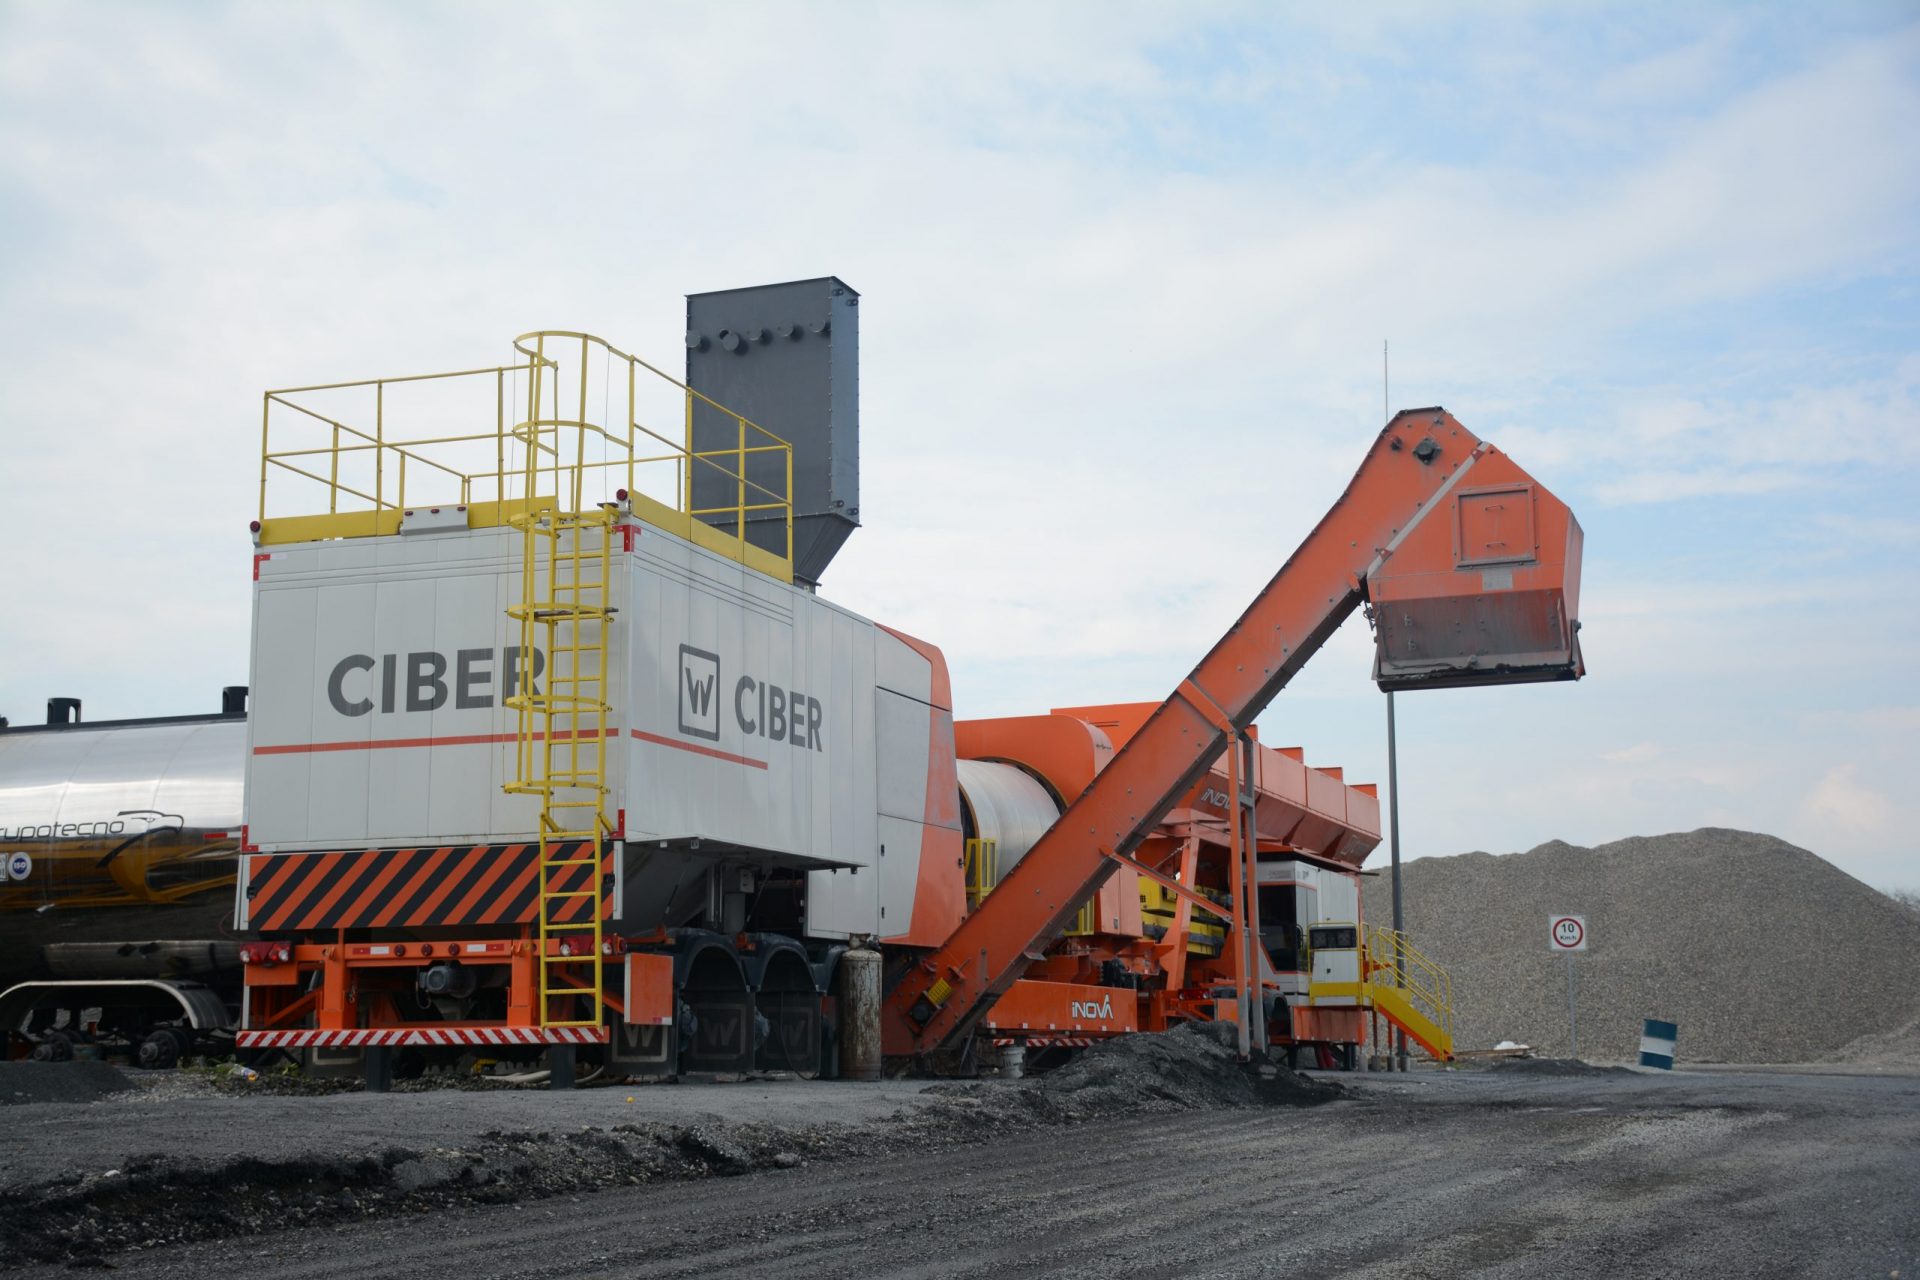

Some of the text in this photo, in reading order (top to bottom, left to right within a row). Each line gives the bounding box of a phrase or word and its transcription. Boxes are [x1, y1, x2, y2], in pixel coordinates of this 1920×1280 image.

[327, 646, 546, 717] CIBER
[734, 675, 823, 752] CIBER
[0, 821, 124, 841] upotecno
[1561, 923, 1574, 933] 10
